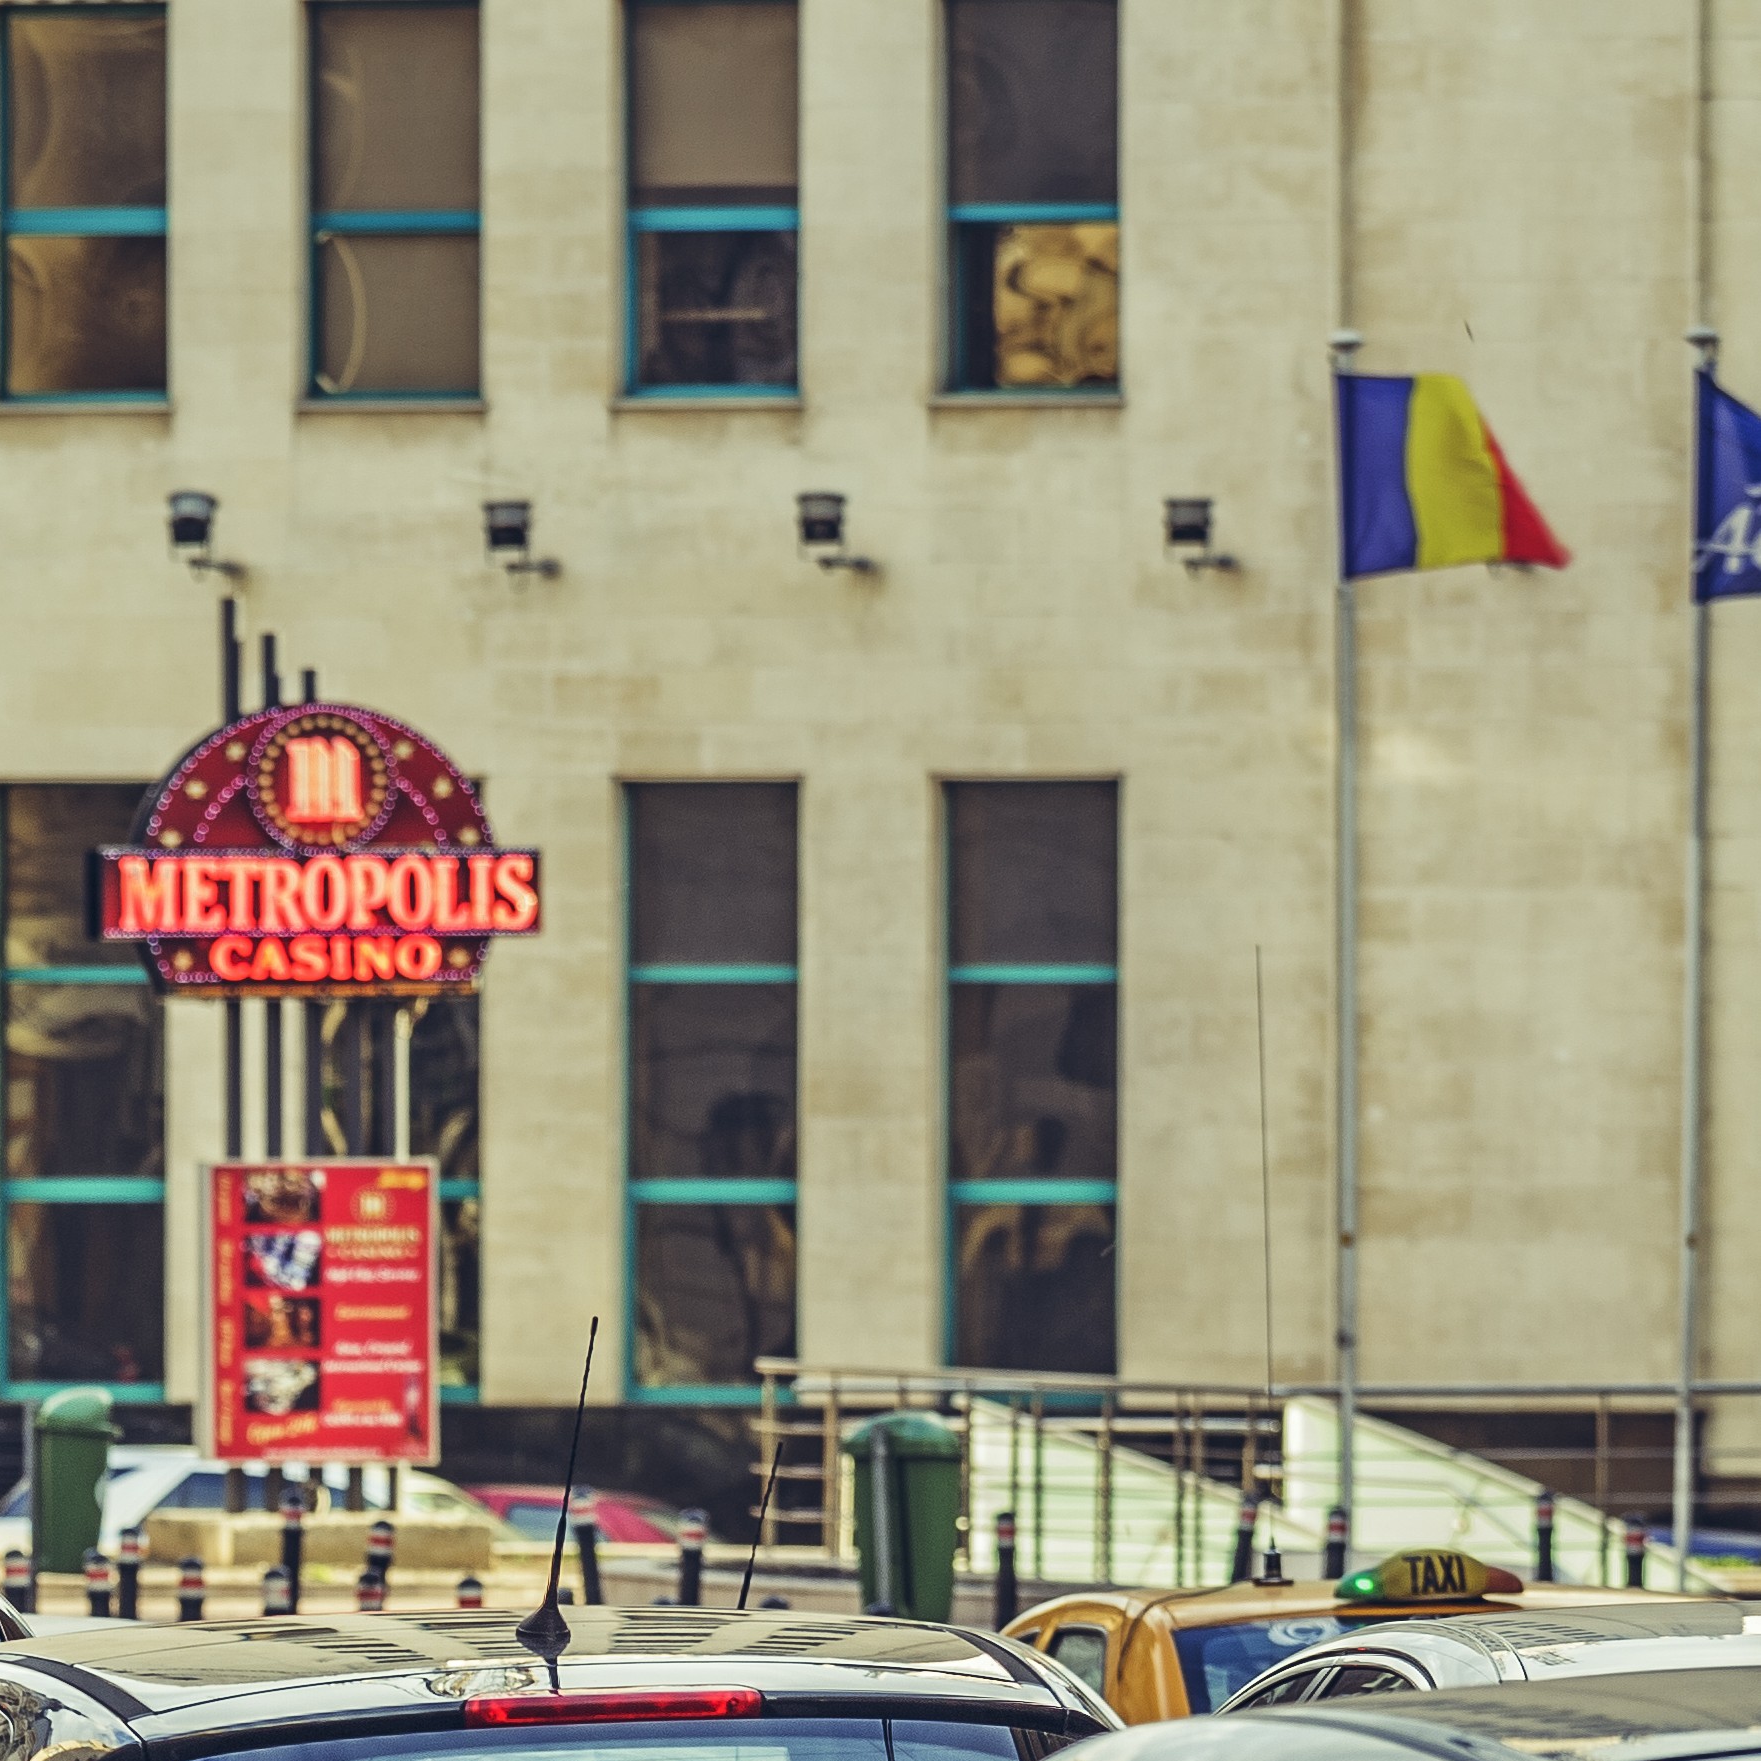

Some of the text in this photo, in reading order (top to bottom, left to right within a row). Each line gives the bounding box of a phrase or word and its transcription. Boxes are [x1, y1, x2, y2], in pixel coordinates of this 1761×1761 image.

[117, 853, 540, 933] METROPOLIS
[208, 933, 443, 982] CASINO
[1400, 1554, 1468, 1596] TAXI
